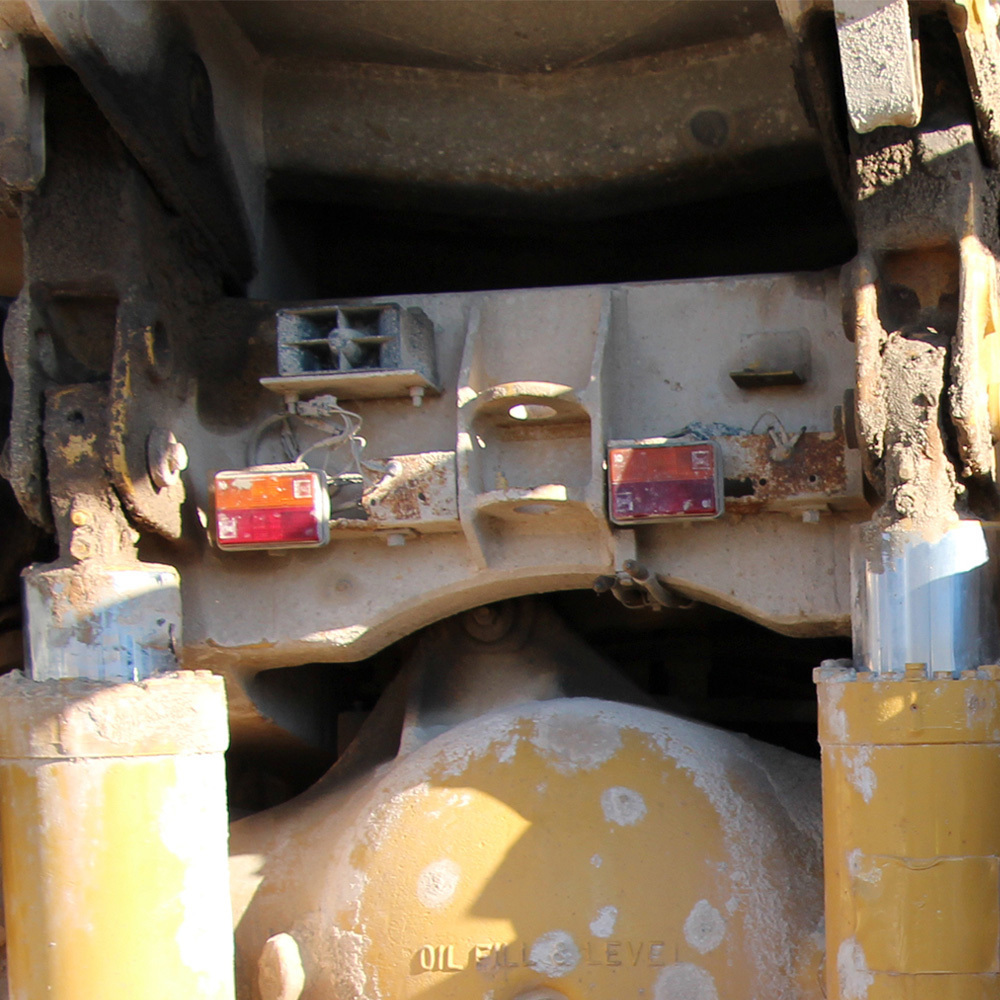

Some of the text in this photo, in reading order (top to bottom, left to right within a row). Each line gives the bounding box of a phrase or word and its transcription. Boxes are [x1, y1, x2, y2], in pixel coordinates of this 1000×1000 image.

[420, 944, 464, 970] OIL
[474, 943, 538, 968] FILL
[586, 941, 686, 967] LEVEL
